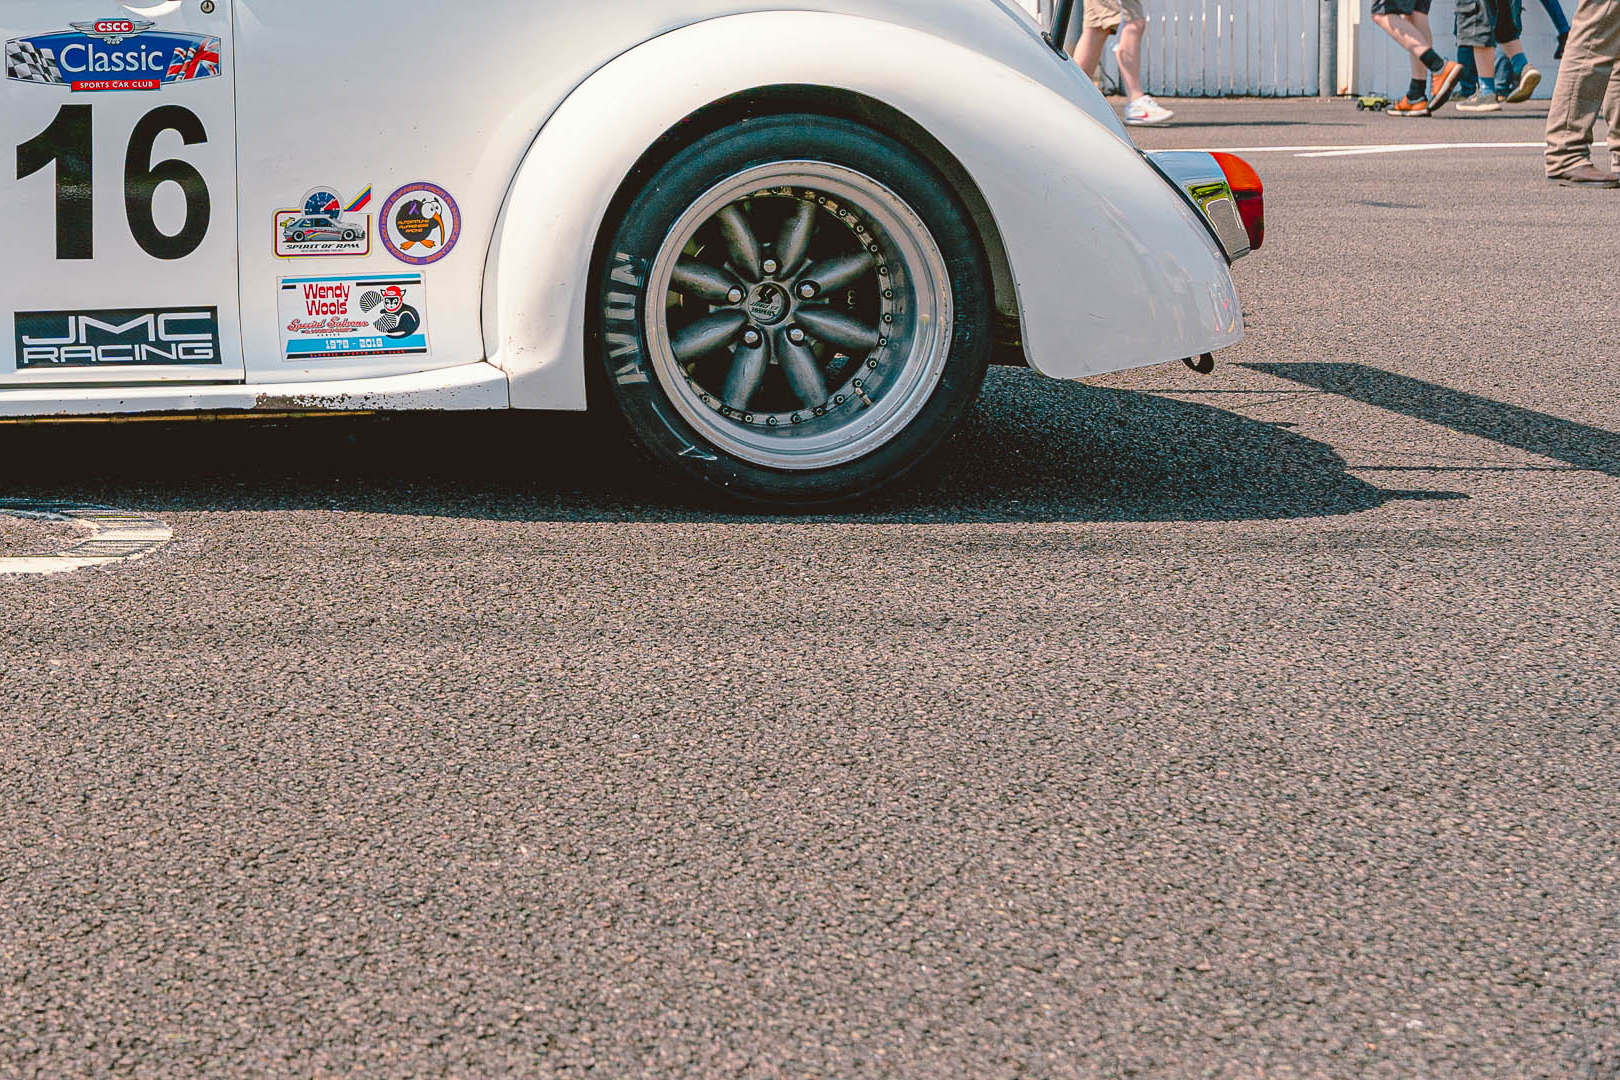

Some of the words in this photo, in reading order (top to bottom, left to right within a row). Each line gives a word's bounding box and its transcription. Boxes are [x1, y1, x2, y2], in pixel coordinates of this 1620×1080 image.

[97, 22, 129, 31] CSCC
[60, 43, 164, 72] Classic
[80, 81, 109, 89] SPORTS
[16, 104, 211, 260] 16
[303, 282, 350, 302] Wendy
[306, 299, 347, 316] Wools
[21, 311, 213, 345] JMC
[23, 343, 214, 364] RACING
